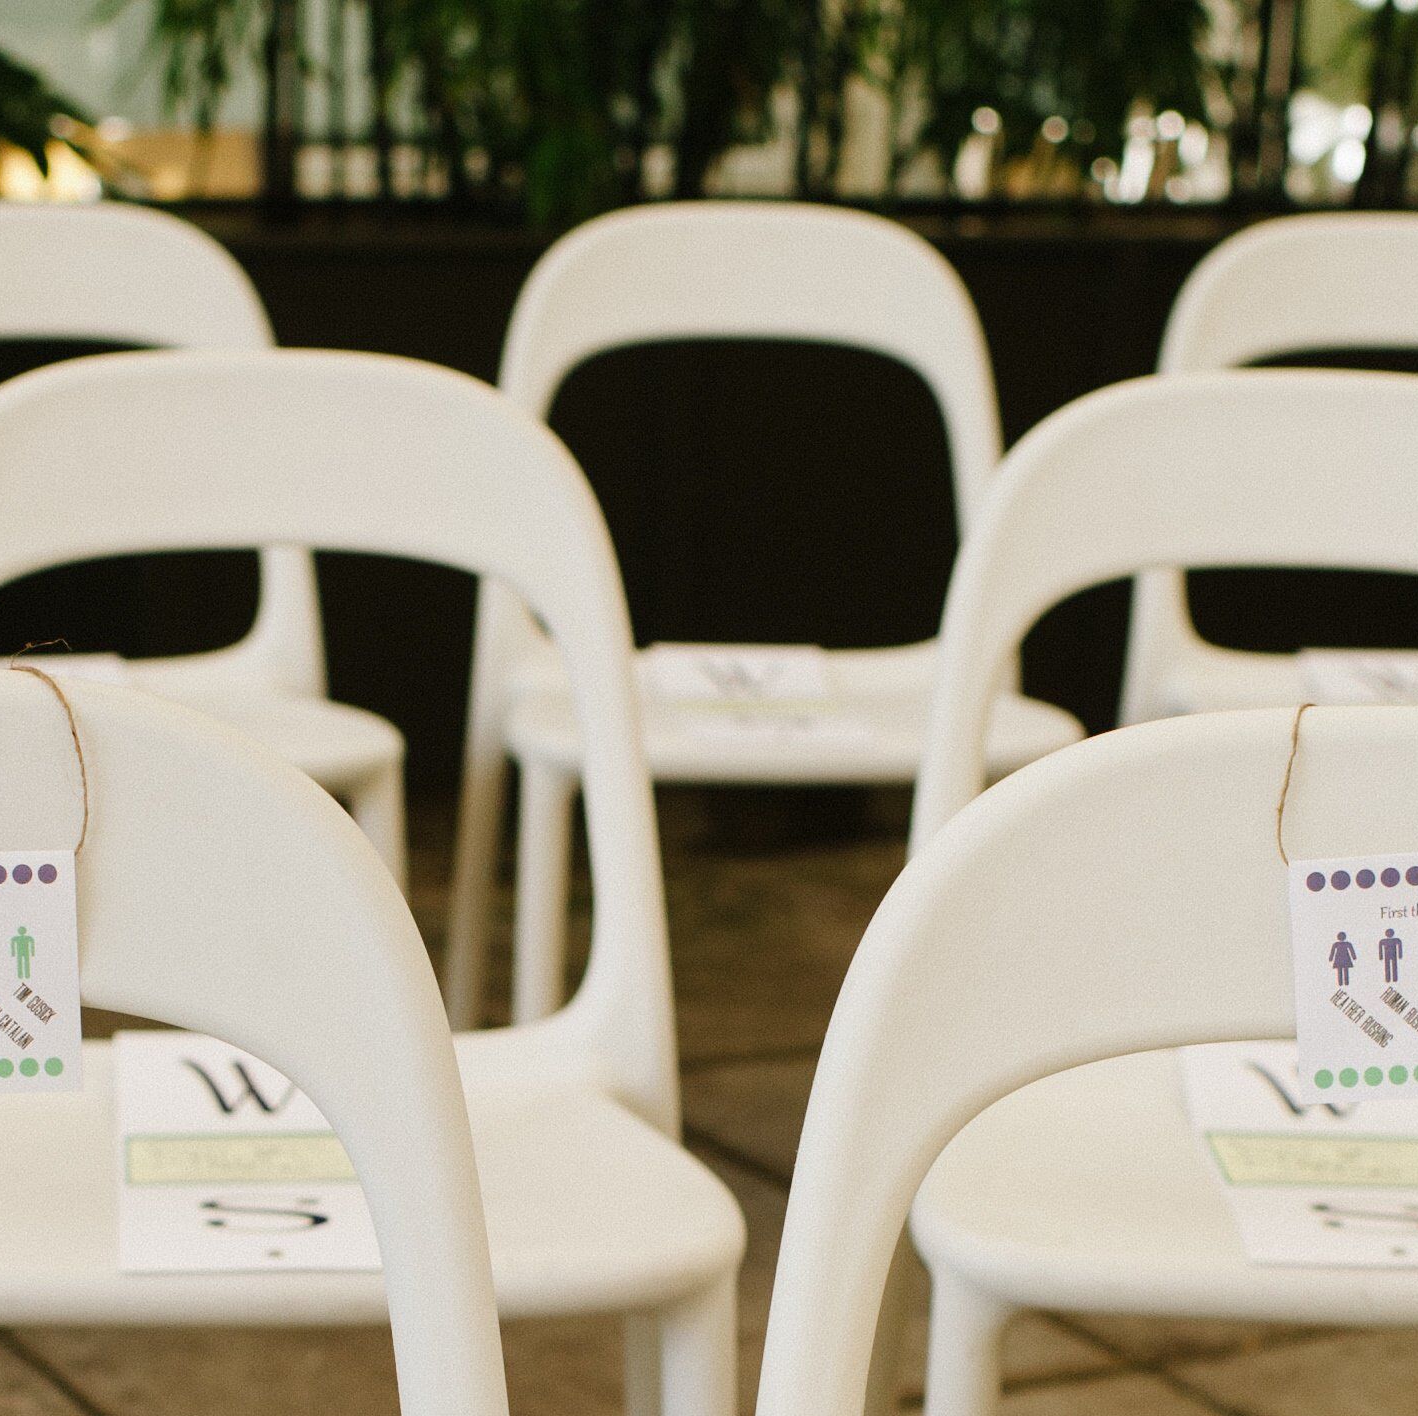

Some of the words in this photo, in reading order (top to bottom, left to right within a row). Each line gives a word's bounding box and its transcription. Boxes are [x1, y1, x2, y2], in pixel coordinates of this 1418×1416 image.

[1380, 907, 1408, 919] First
[13, 982, 32, 1003] TIM
[1380, 986, 1410, 1015] ROMAN
[1329, 988, 1366, 1024] HEATHER
[1359, 1015, 1394, 1048] RUSHING
[182, 1058, 297, 1114] W
[200, 1196, 329, 1234] S
